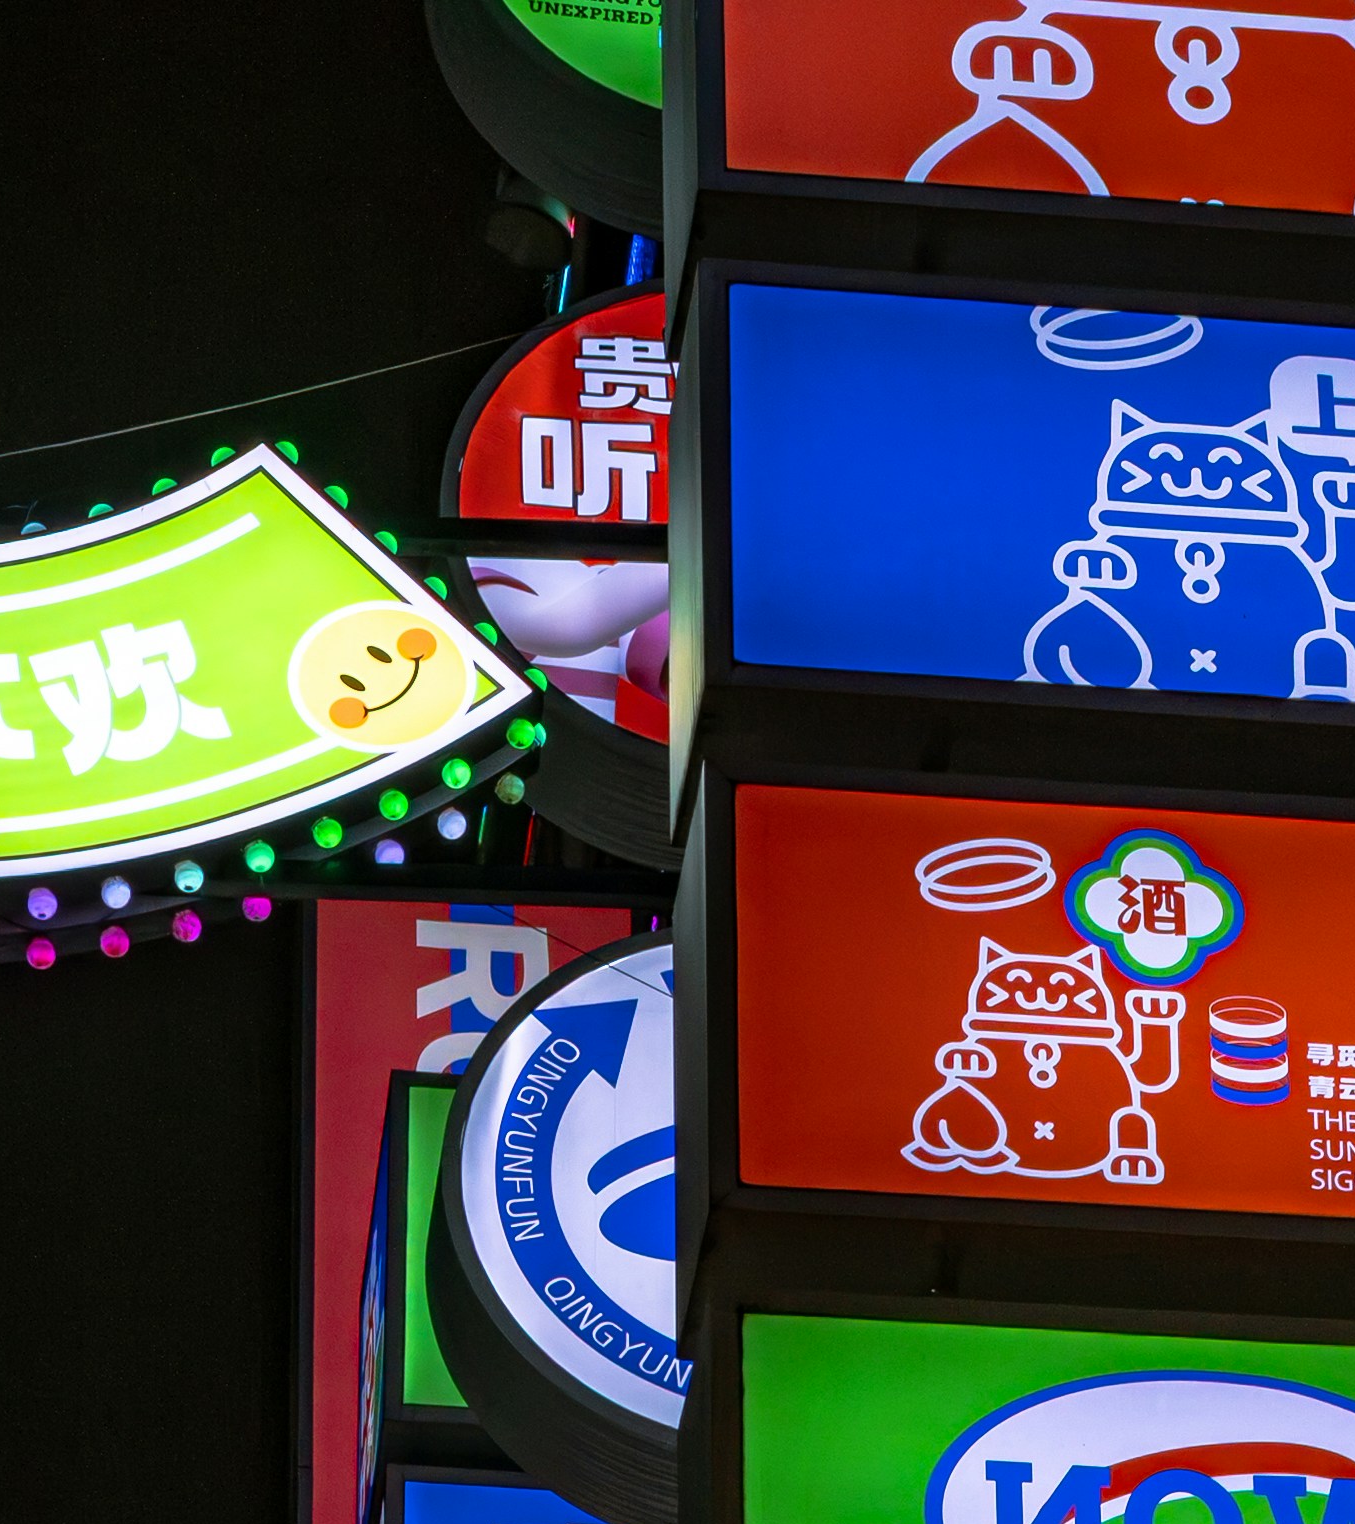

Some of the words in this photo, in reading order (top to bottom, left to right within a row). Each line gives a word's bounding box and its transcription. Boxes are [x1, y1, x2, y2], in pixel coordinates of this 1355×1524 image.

[521, 416, 656, 521] 听
[1116, 876, 1188, 938] 酒
[501, 1036, 581, 1245] QINGYUNFUN
